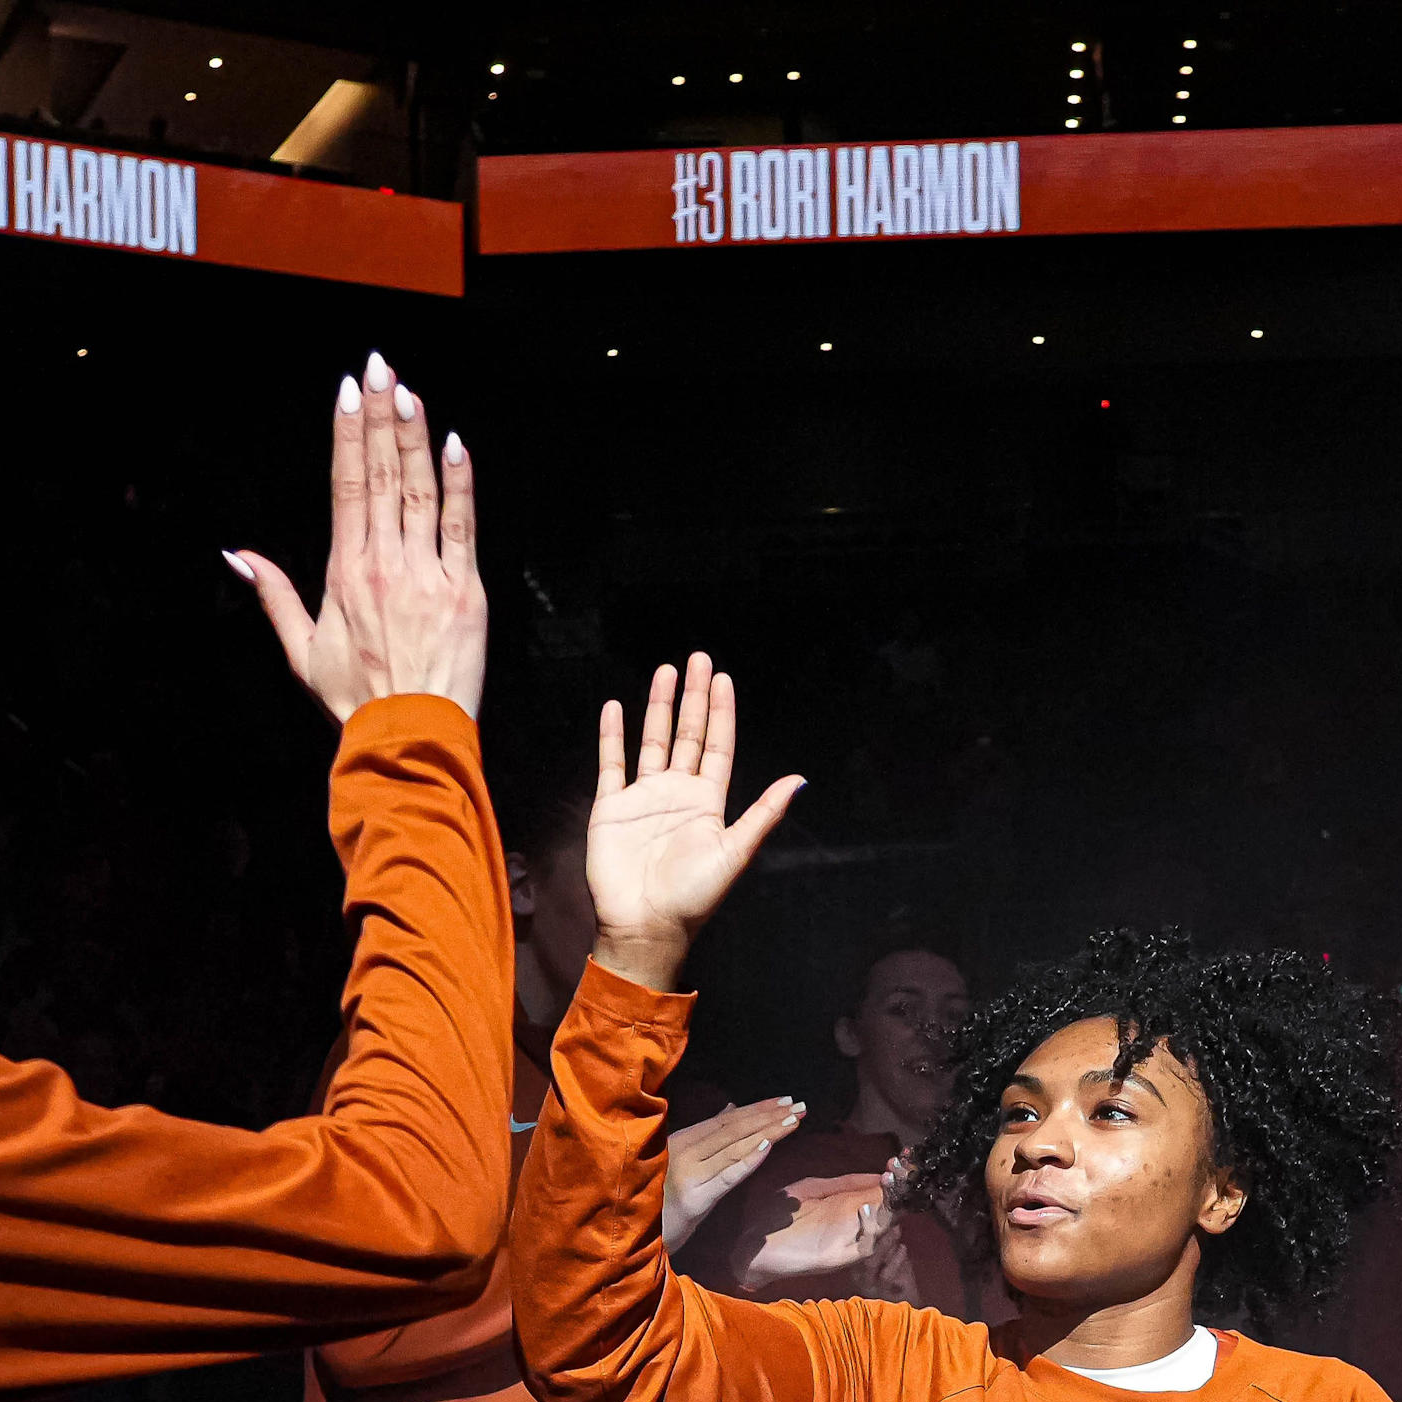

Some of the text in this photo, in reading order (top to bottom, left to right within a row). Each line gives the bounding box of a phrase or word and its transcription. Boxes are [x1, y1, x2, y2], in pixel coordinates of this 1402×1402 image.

[12, 139, 198, 256] HARMON
[672, 140, 1021, 243] #3 RORI HARMON
